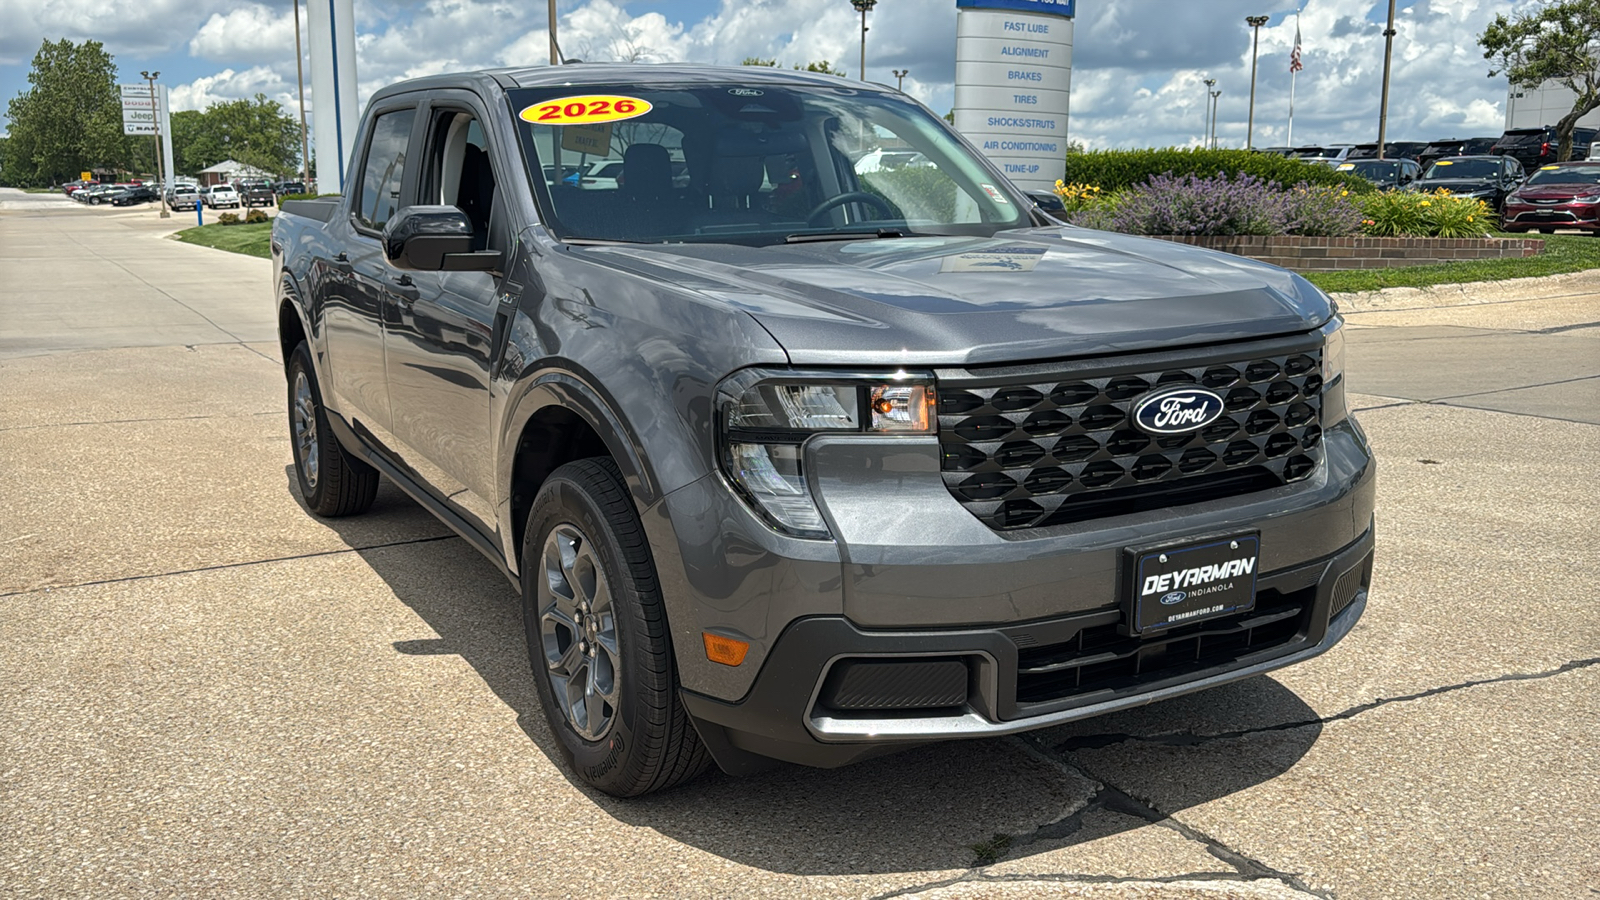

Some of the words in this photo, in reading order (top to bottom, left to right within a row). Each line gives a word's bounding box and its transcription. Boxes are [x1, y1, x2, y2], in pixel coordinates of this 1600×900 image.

[1004, 21, 1026, 32] FAST
[1028, 22, 1049, 34] LUBE
[1001, 46, 1049, 58] ALIGNMENT
[1008, 71, 1042, 82] BRAKES
[1013, 95, 1037, 105] TIRES
[131, 111, 153, 120] Jeep
[537, 99, 637, 121] 2026
[987, 117, 1056, 129] SHOCKS/STRUTS
[983, 141, 999, 150] AIR
[1001, 141, 1057, 152] CONDITIONING
[1004, 164, 1039, 174] TUNE-UP
[1153, 395, 1209, 428] Ford
[1141, 556, 1256, 597] DEYARMAN
[1188, 582, 1234, 598] INDIANOLA
[1164, 592, 1183, 603] Ford
[1168, 604, 1224, 622] DEYARMANFORD.COM
